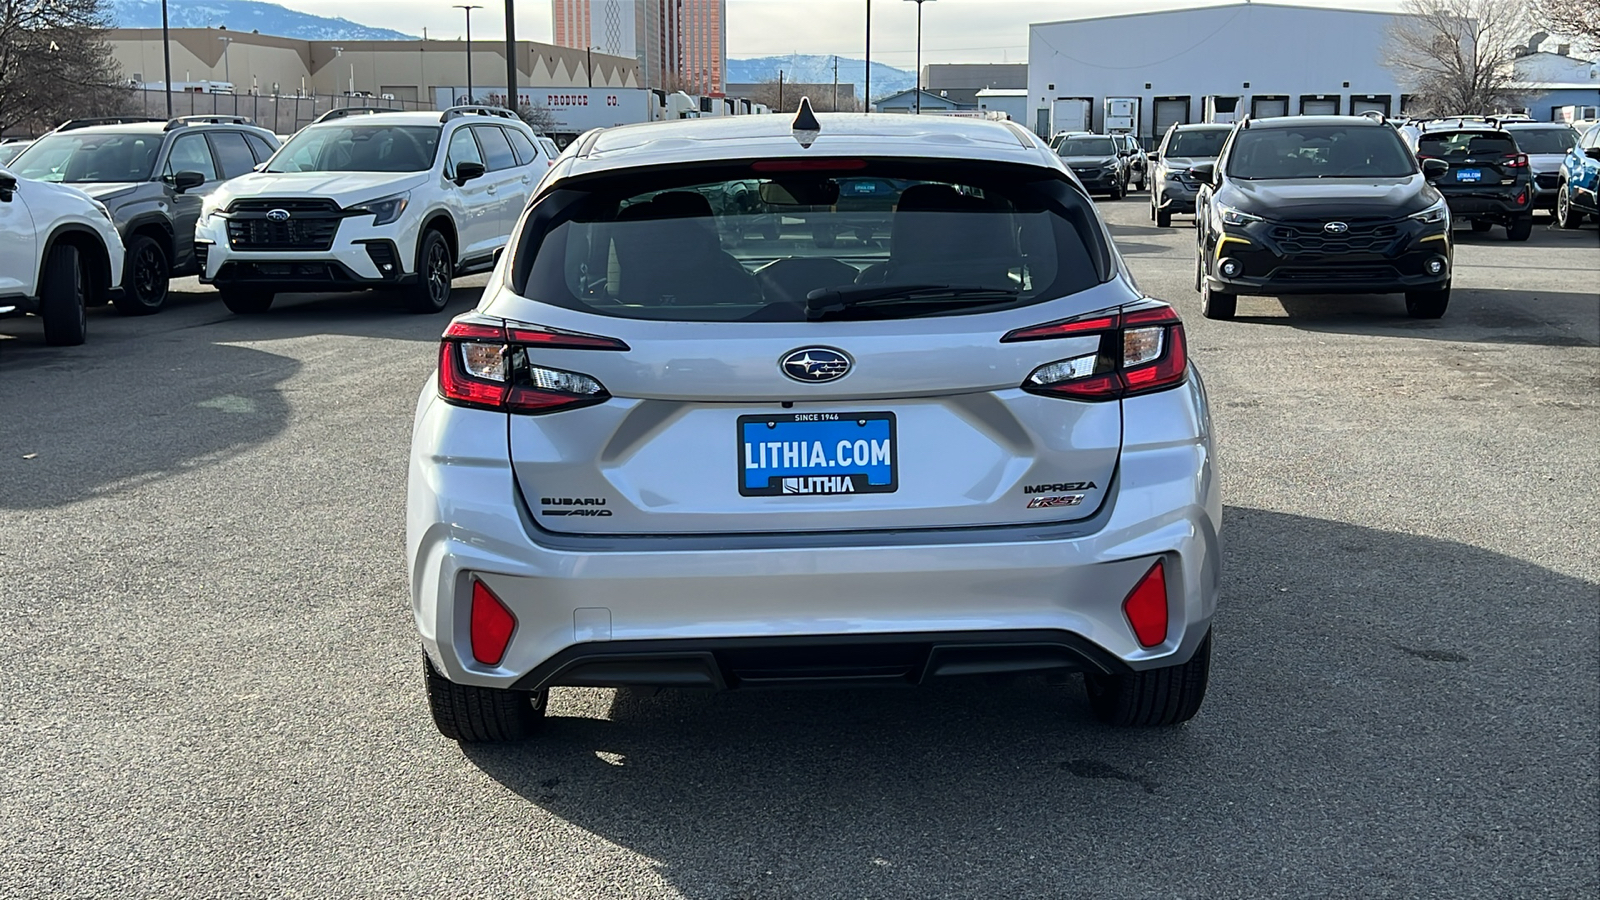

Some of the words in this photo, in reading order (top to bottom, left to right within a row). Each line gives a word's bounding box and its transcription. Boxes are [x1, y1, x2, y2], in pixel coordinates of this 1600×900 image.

[489, 94, 531, 105] BONZA
[547, 94, 589, 106] PRODUCE
[607, 95, 620, 106] CO.
[745, 439, 890, 469] LITHIA.COM
[798, 476, 855, 493] LITHIA
[1024, 481, 1098, 494] IMPREZA
